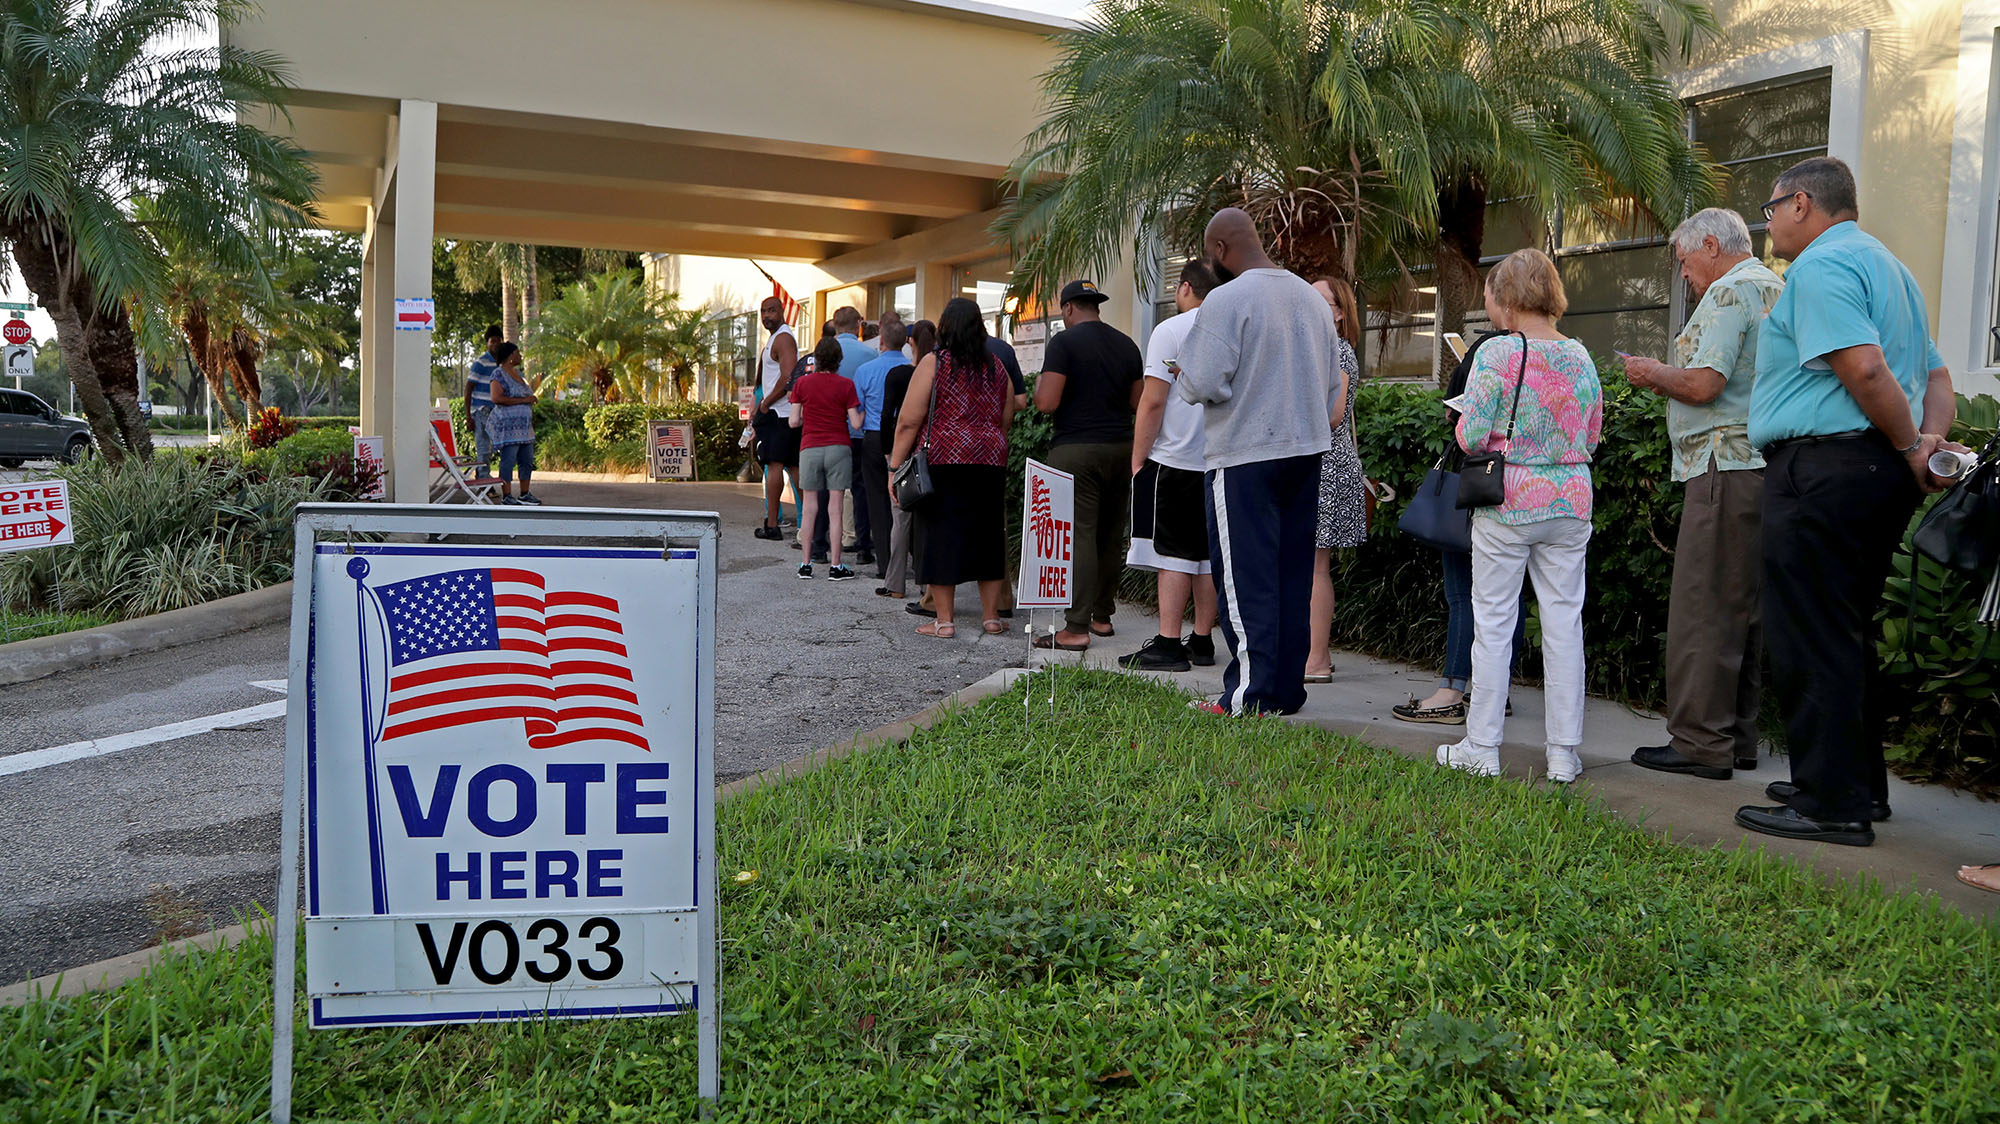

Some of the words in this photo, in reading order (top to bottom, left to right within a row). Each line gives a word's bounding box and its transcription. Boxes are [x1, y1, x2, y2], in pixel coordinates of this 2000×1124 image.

[5, 327, 30, 337] STOP
[657, 448, 688, 457] VOTE
[662, 457, 683, 465] HERE
[0, 487, 61, 502] OTE
[1, 500, 64, 515] ERE
[0, 526, 13, 538] TE
[17, 522, 51, 537] HERE
[1036, 515, 1071, 561] VOTE
[1038, 565, 1067, 598] HERE
[387, 762, 670, 838] VOTE
[435, 848, 625, 900] HERE
